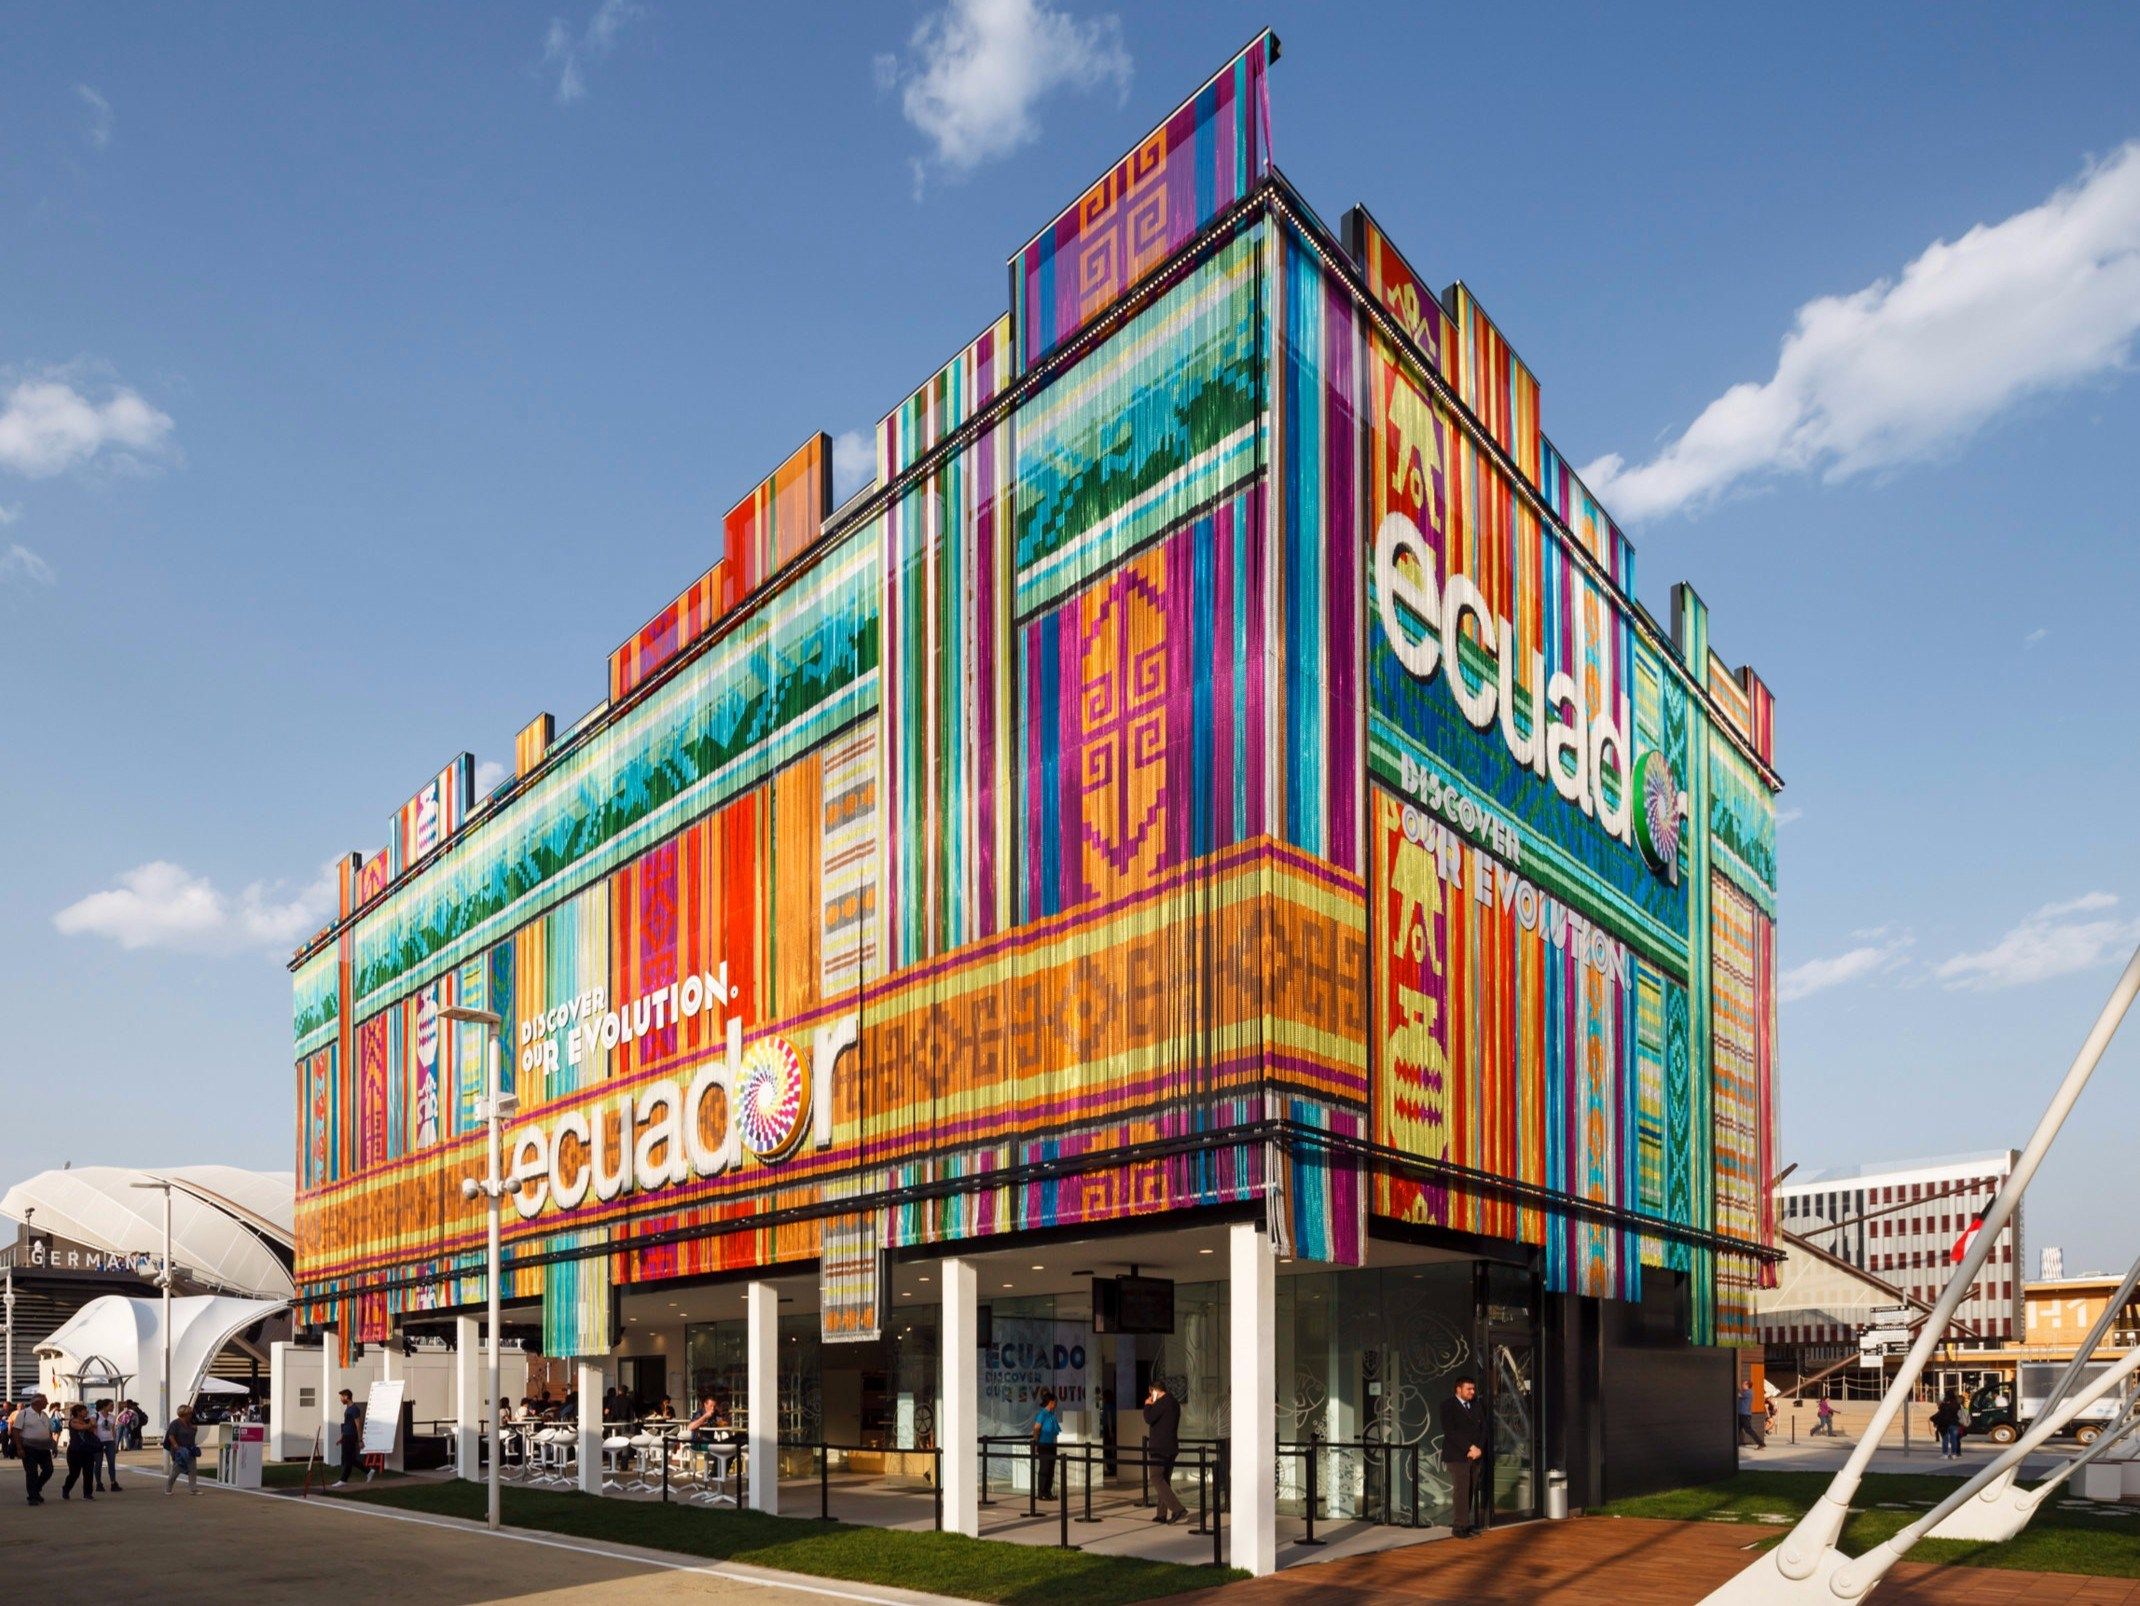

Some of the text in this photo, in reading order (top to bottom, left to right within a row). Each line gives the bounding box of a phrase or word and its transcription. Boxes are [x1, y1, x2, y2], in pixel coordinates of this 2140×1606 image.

[1400, 751, 1521, 866] DISCOVER
[1401, 804, 1462, 890] OUR
[521, 986, 606, 1046] DISCOVER
[522, 1039, 560, 1075] OUR
[512, 1015, 859, 1219] ecuador
